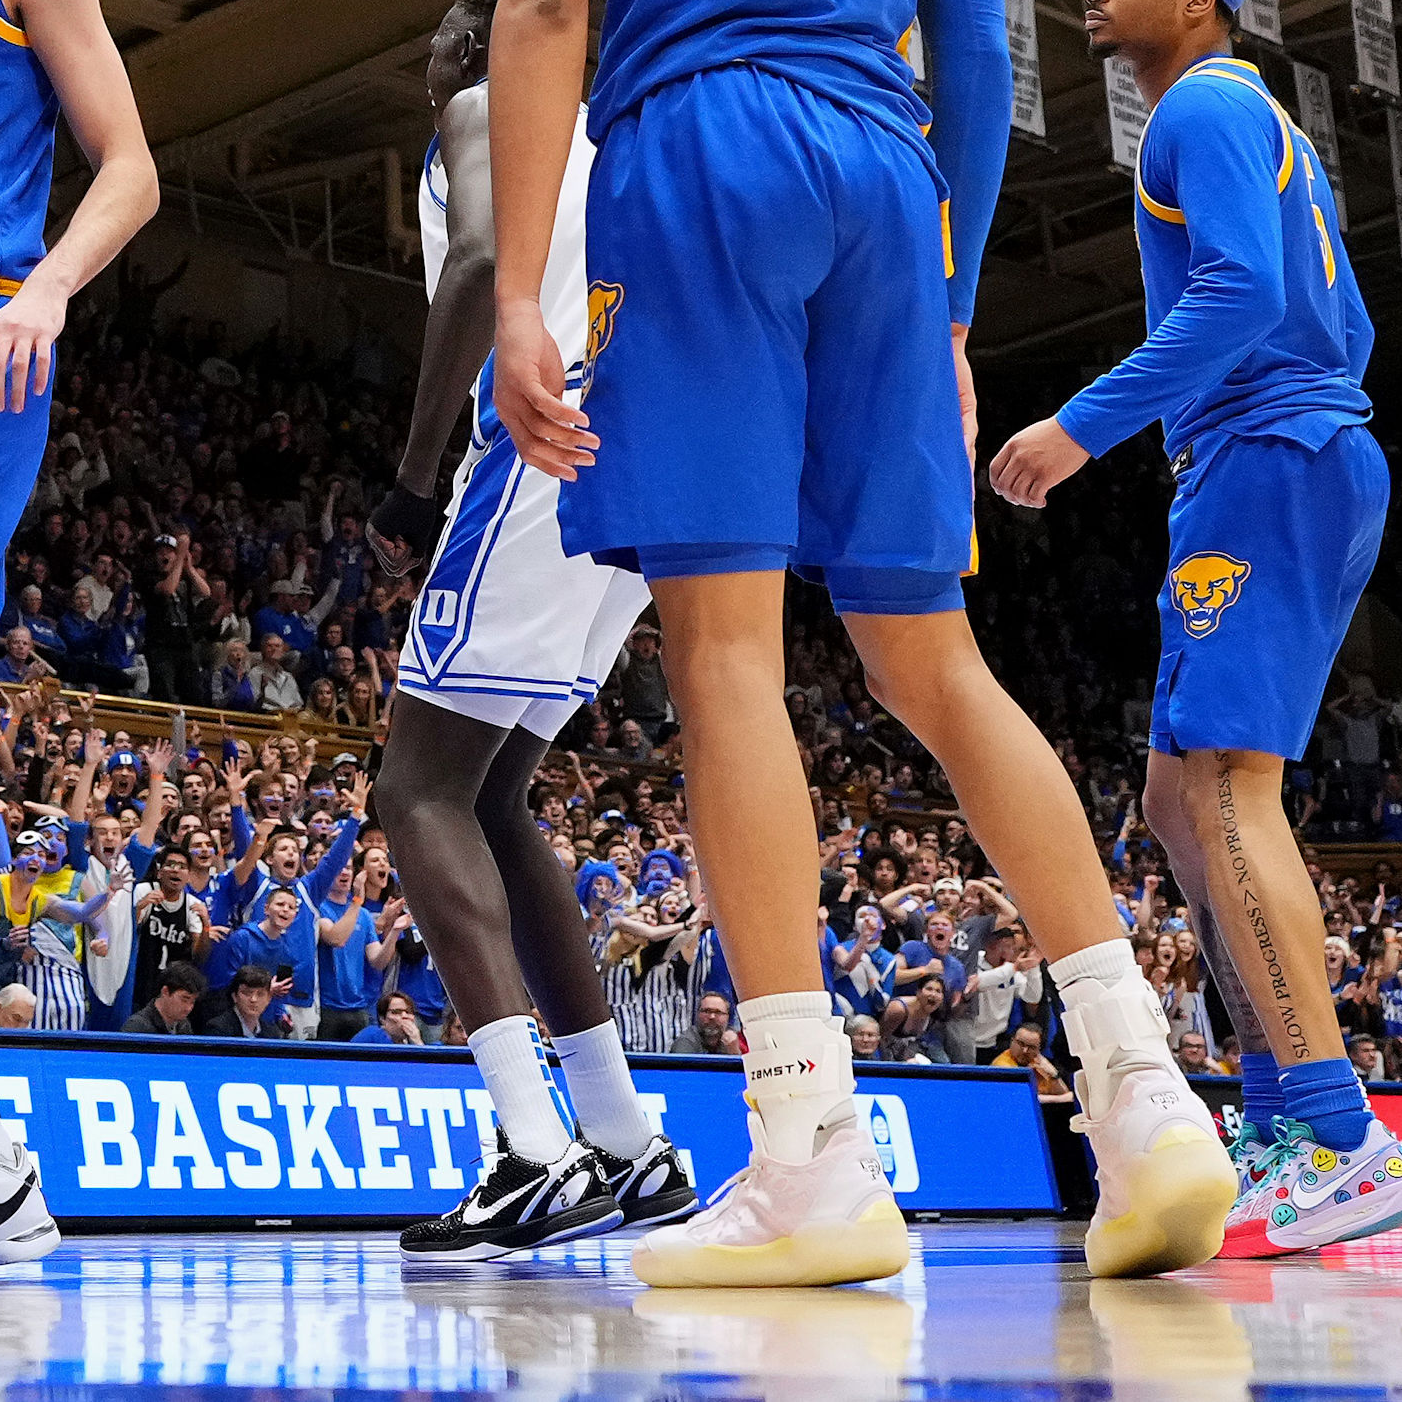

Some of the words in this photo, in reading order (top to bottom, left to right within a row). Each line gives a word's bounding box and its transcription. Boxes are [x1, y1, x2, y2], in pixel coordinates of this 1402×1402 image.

[150, 915, 187, 944] Duke
[159, 945, 168, 970] 1
[1232, 858, 1252, 886] NO
[1246, 906, 1289, 1005] PROGRESS
[1279, 1003, 1311, 1060] SLOW
[65, 1078, 697, 1190] BASKET
